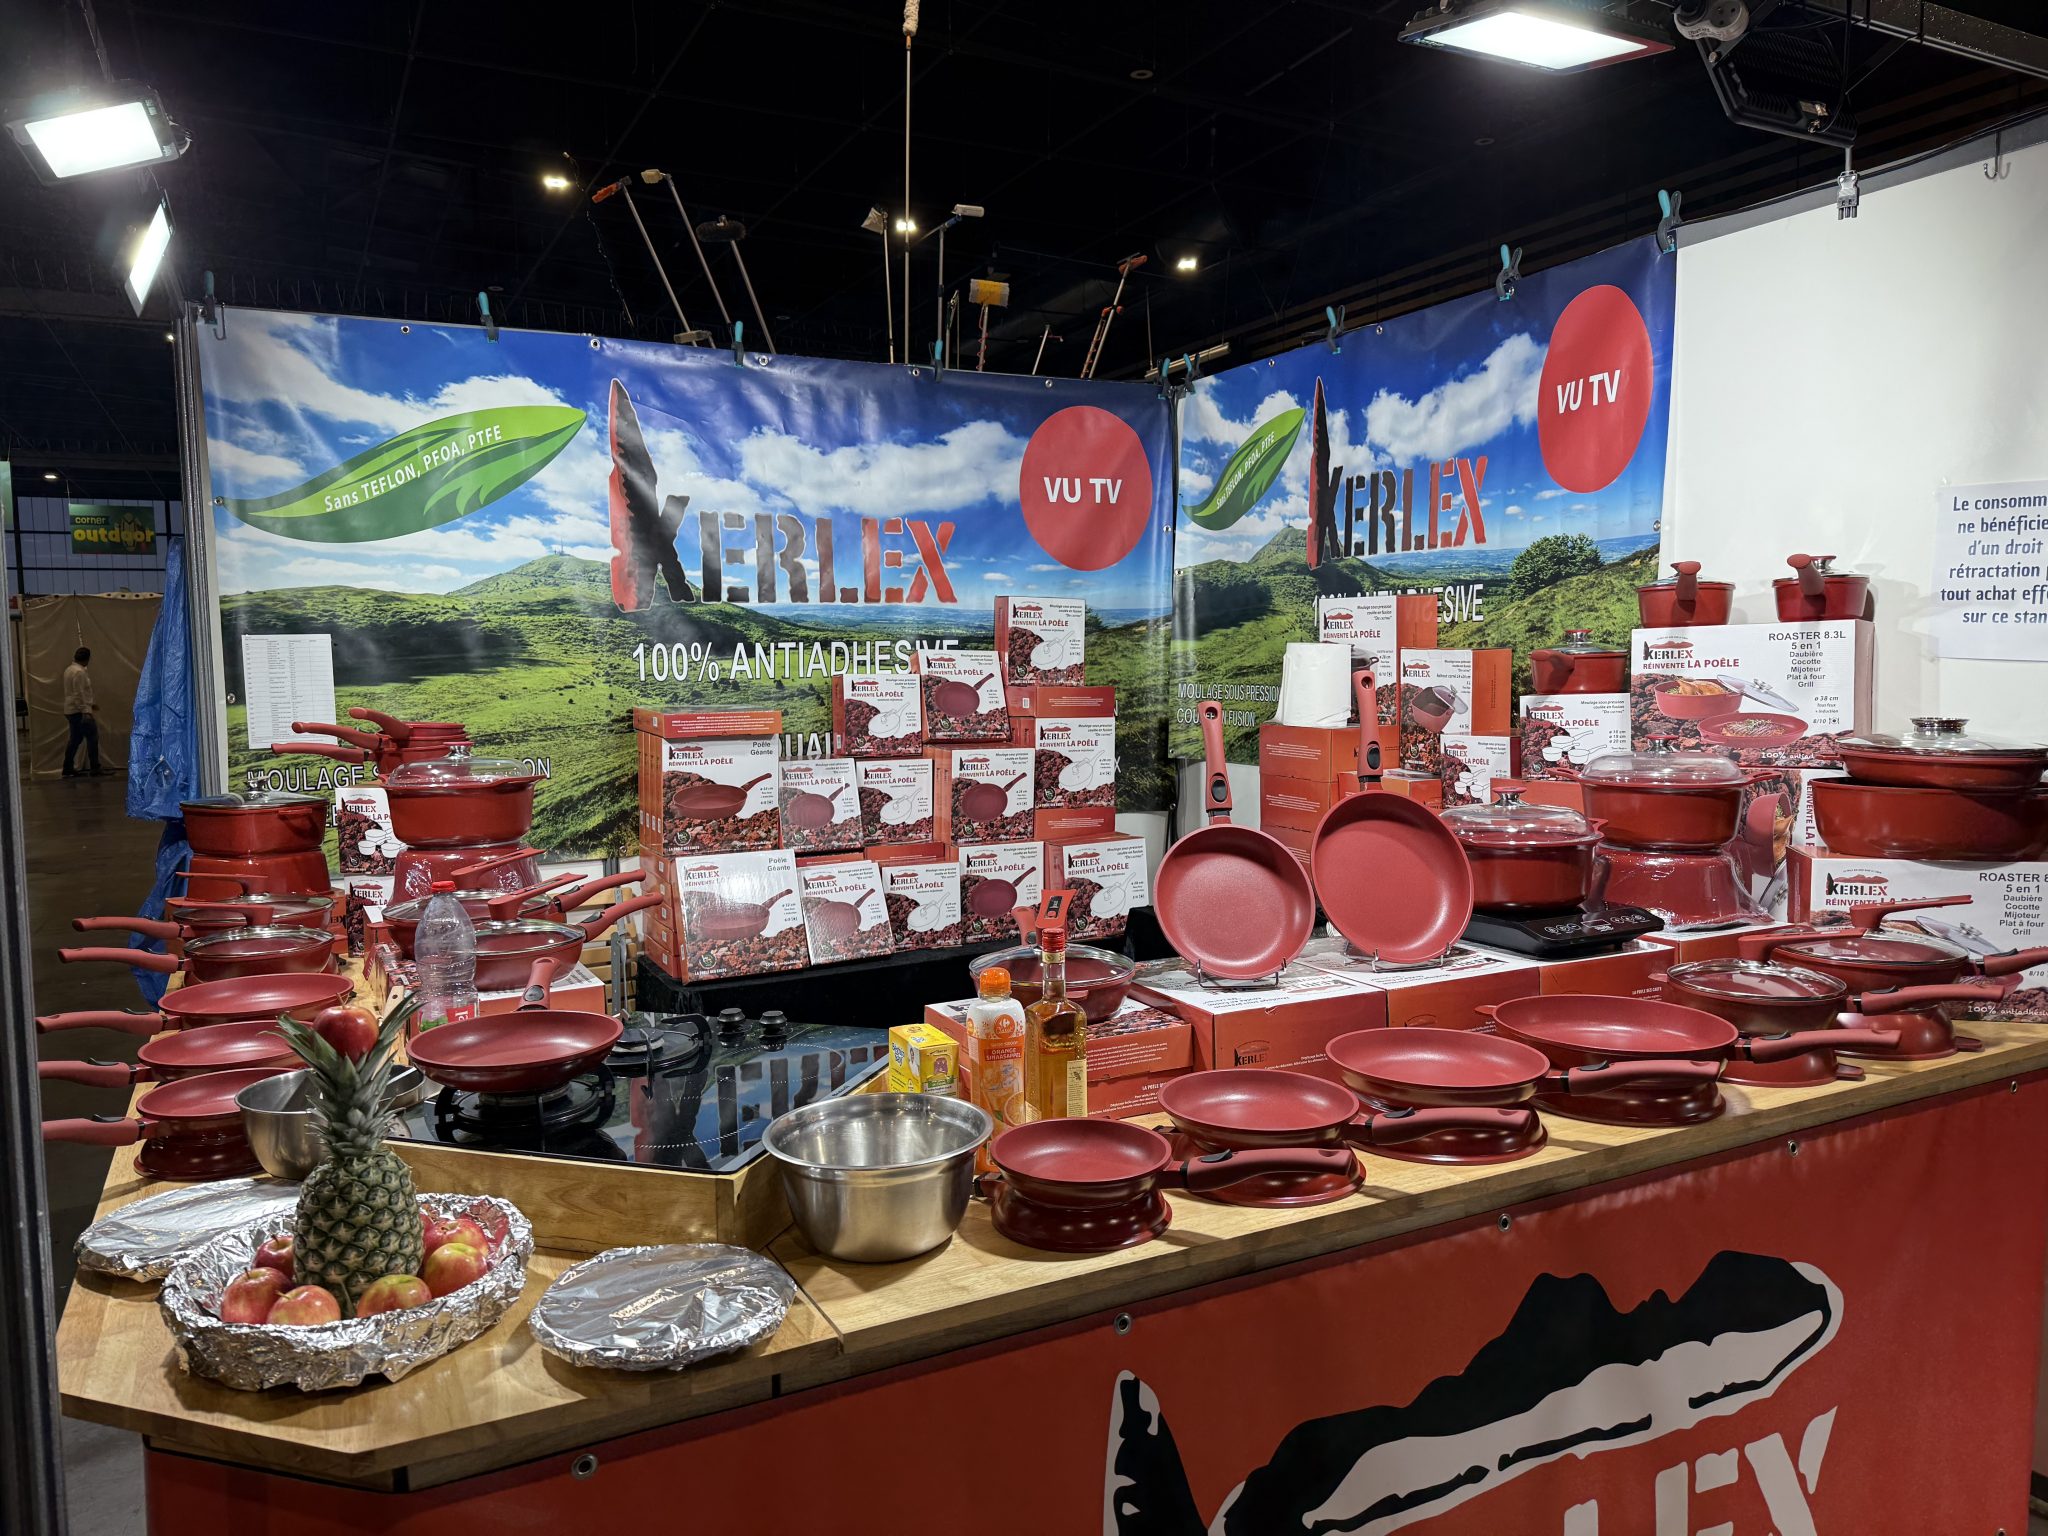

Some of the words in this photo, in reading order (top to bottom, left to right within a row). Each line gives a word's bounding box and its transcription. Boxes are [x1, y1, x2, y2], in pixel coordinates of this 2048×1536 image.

[1557, 383, 1583, 415] VU
[1588, 369, 1621, 405] TV
[325, 493, 358, 512] Sans
[361, 463, 421, 500] TEFLON,
[423, 441, 467, 472] PFOA,
[468, 425, 502, 450] PTFE
[1307, 376, 1488, 570] KERLEX
[609, 377, 958, 614] KERLEX
[1044, 476, 1081, 503] VU
[1089, 477, 1123, 505] TV
[1953, 496, 1969, 511] Le
[1974, 495, 2047, 510] consomm
[75, 516, 106, 525] corner
[1958, 522, 1975, 534] ne
[73, 523, 154, 543] outdoor
[1968, 540, 2000, 556] d'un
[2005, 538, 2043, 554] droit
[1949, 562, 2040, 578] rétractation
[1941, 588, 1971, 601] tout
[1976, 585, 2017, 601] achat
[2022, 584, 2048, 605] eff
[1012, 603, 1043, 618] KERLEX
[1962, 612, 1987, 623] sur
[1992, 612, 2008, 623] ce
[2014, 610, 2048, 624] stan
[1323, 612, 1354, 630] KERLEX
[1350, 630, 1358, 638] LA
[1768, 631, 1821, 641] ROASTER
[1824, 631, 1846, 639] 8.3L
[1643, 641, 1694, 660] KERLEX
[1791, 642, 1797, 650] 5
[1816, 641, 1821, 649] 1
[632, 641, 721, 683] 100%
[729, 639, 959, 680] ANTIADHES
[926, 656, 957, 669] KERLEX
[1687, 659, 1701, 668] LA
[1704, 658, 1740, 668] POÊLE
[1402, 661, 1431, 678] KERLEX
[851, 679, 879, 692] KERLEX
[1177, 682, 1223, 700] MOULAGE
[1224, 684, 1244, 700] SOUS
[1246, 685, 1281, 702] PRESSION
[1228, 710, 1255, 727] FUSION
[1526, 704, 1564, 720] KERLEX
[1040, 725, 1071, 740] KERLEX
[668, 746, 704, 760] KERLEX
[959, 756, 990, 771] KERLEX
[782, 766, 814, 781] KERLEX
[864, 767, 892, 780] KERLEX
[341, 797, 376, 814] KERLEX
[372, 813, 382, 821] LA
[1805, 826, 1815, 839] LA
[966, 853, 998, 868] KERLEX
[1068, 853, 1100, 869] KERLEX
[803, 876, 837, 890] KERLEX
[890, 872, 919, 886] KERLEX
[1825, 872, 1888, 896] KERLEX
[1979, 872, 2040, 883] ROASTER
[349, 882, 383, 899] KERLEX
[2006, 884, 2013, 893] 5
[2035, 884, 2040, 893] 1
[2003, 894, 2043, 902] Daubière
[2004, 911, 2040, 920] Mijoteur
[2012, 928, 2031, 936] Grill
[1967, 1005, 1997, 1014] 100%
